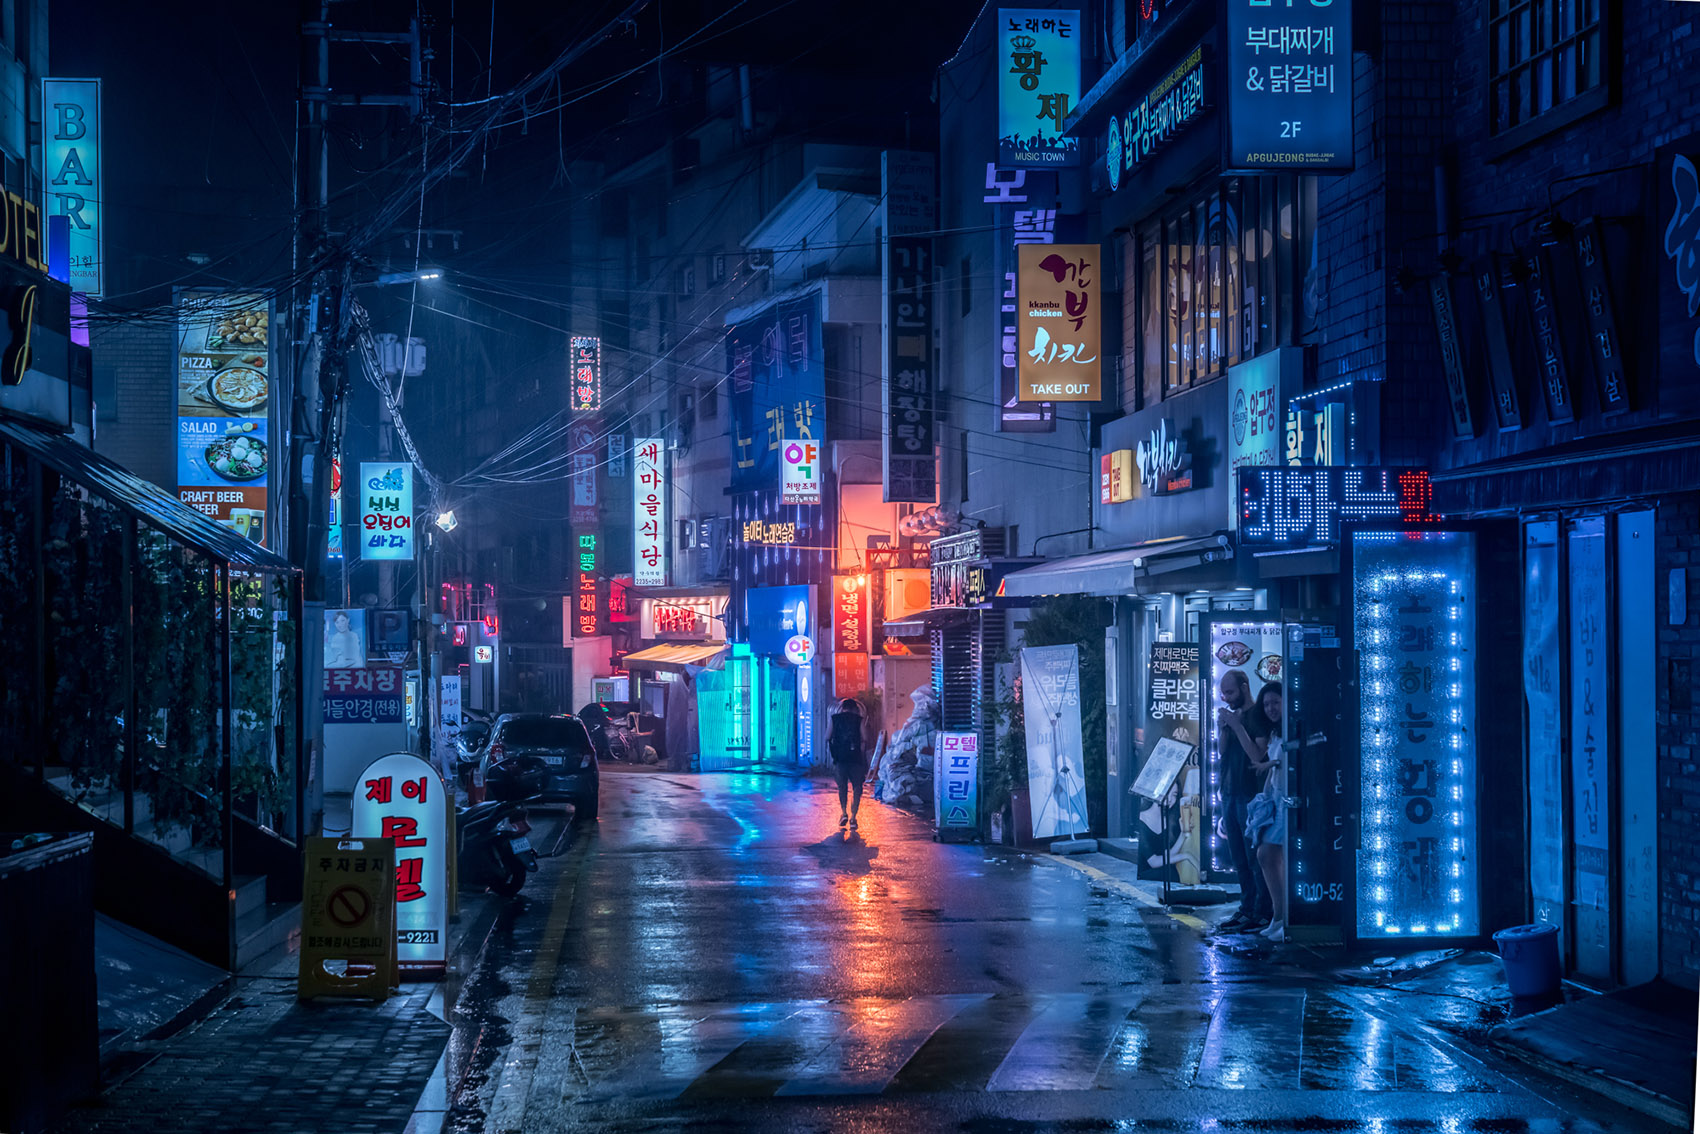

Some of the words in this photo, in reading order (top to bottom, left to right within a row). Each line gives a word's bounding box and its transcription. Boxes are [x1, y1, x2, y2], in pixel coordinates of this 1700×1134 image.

[1008, 18, 1072, 38] 노래하는
[1246, 26, 1334, 55] 부대찌개
[1246, 66, 1265, 91] &
[1270, 64, 1334, 93] 닭갈비
[1009, 51, 1070, 132] 황제
[1280, 121, 1301, 138] 2F
[1015, 152, 1040, 161] MUSIC
[1042, 153, 1065, 161] TOWN
[1246, 152, 1305, 162] APGUJEONG
[52, 103, 92, 230] BAR
[1029, 301, 1060, 309] kkanbu
[1029, 310, 1063, 318] chicken
[1028, 327, 1097, 364] 치킨
[181, 357, 213, 368] PIZZA
[577, 349, 595, 402] 노래방
[1030, 384, 1062, 394] TAKE
[1065, 384, 1091, 394] OUT
[1250, 384, 1276, 437] 압구정
[181, 422, 217, 433] SALAD
[785, 443, 816, 479] 약
[786, 482, 817, 492] 처방조제
[180, 491, 215, 502] CRAFT
[216, 492, 244, 502] BEER
[639, 443, 662, 567] 새마을식당
[363, 513, 411, 531] 오징어
[368, 534, 406, 548] 바다
[789, 640, 810, 661] 약
[1153, 647, 1199, 661] 제대로만든
[1152, 661, 1190, 674] 진짜맥주
[944, 736, 976, 752] 모텔
[366, 777, 428, 804] 제이
[946, 755, 971, 825] 프린스
